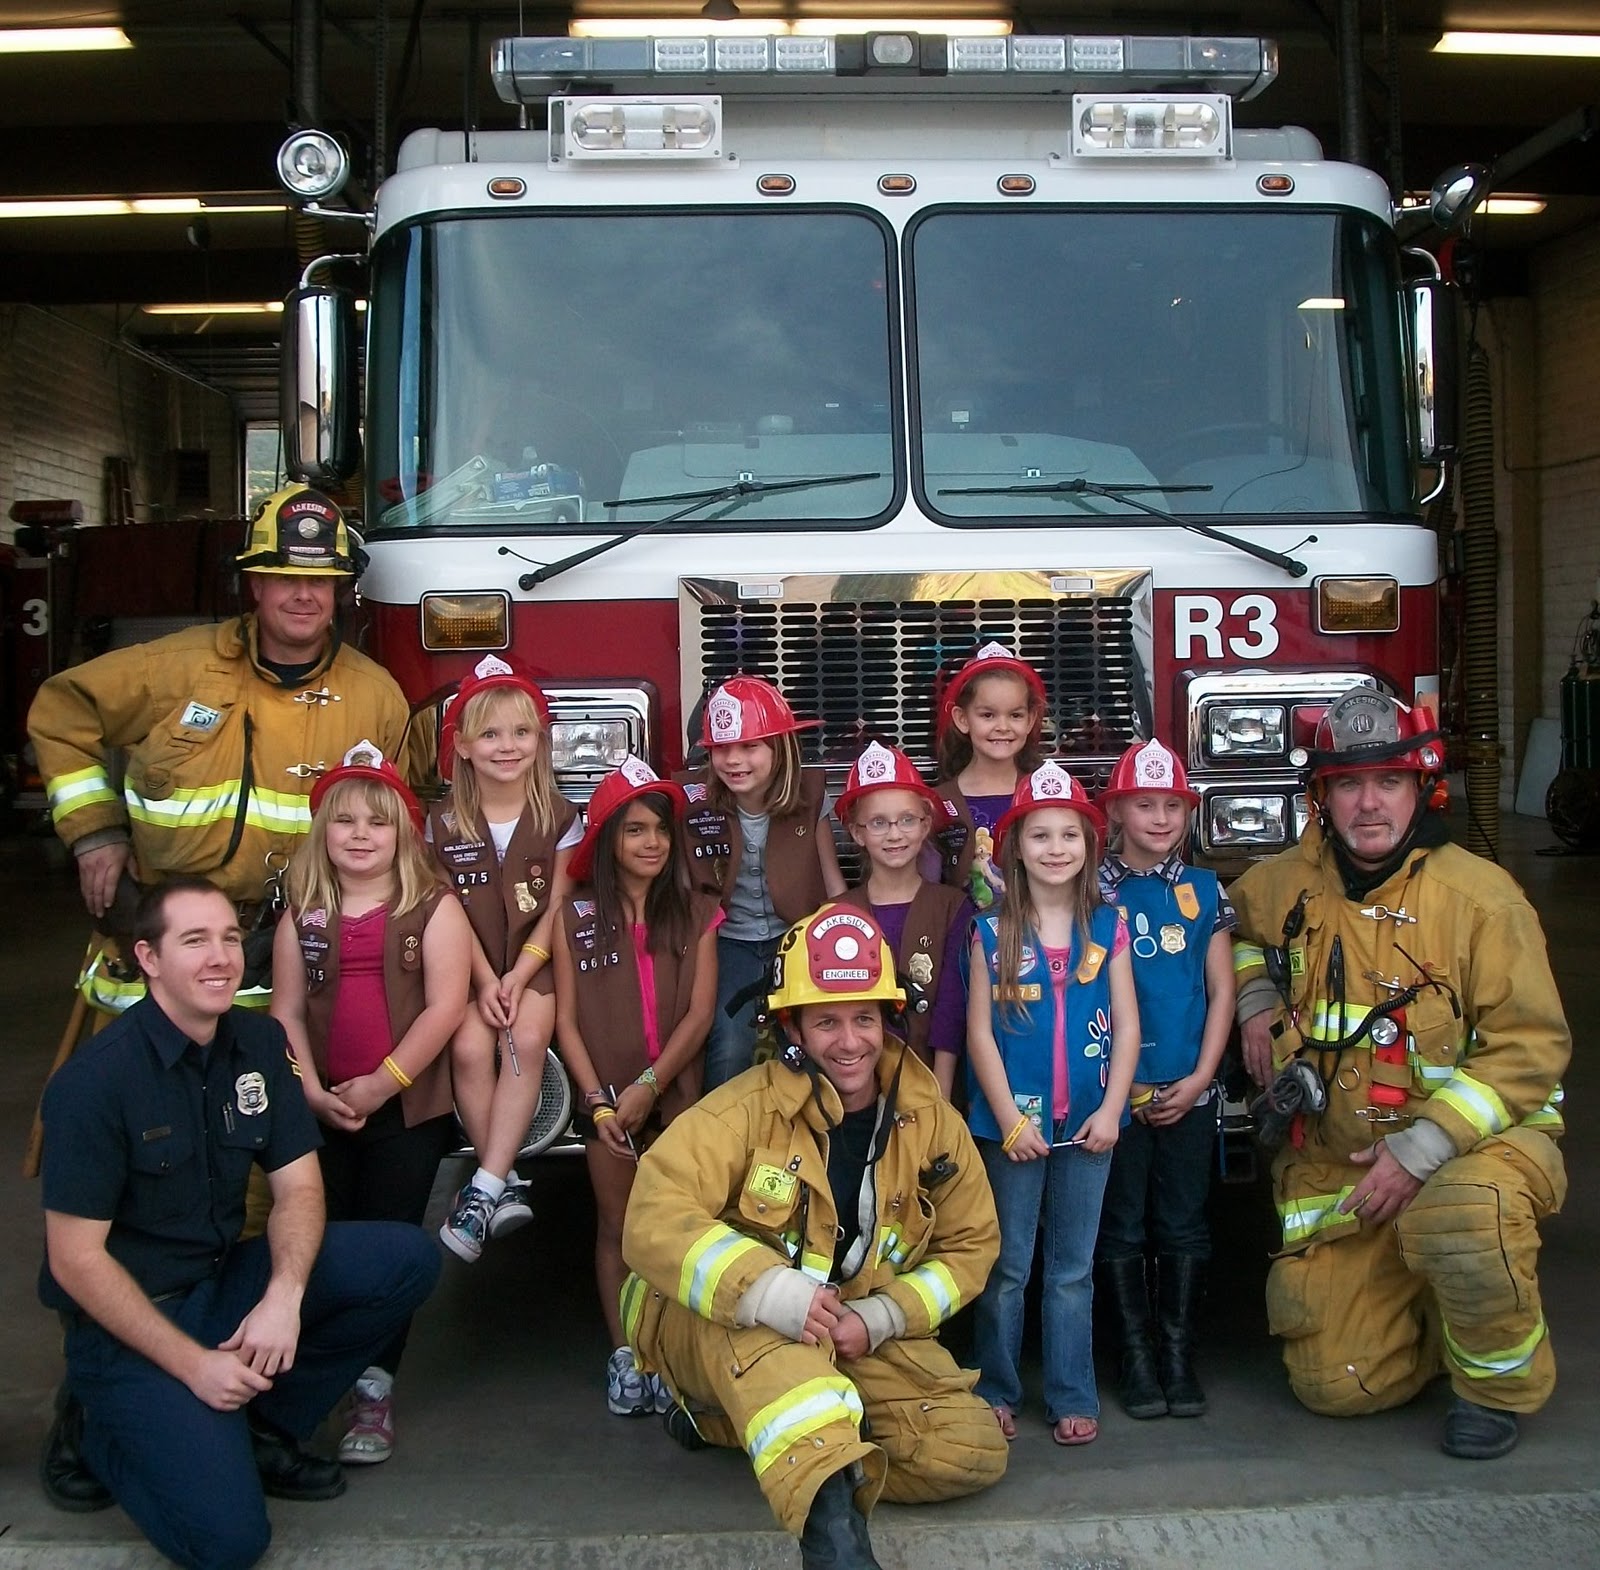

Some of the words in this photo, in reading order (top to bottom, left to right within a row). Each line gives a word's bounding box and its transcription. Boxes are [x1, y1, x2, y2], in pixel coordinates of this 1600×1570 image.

[291, 503, 327, 515] LAKESIDE
[22, 598, 48, 636] 3
[1174, 594, 1279, 659] R3
[695, 844, 730, 858] 6675
[820, 915, 869, 932] LAKESIDE
[825, 970, 867, 979] ENGINEER
